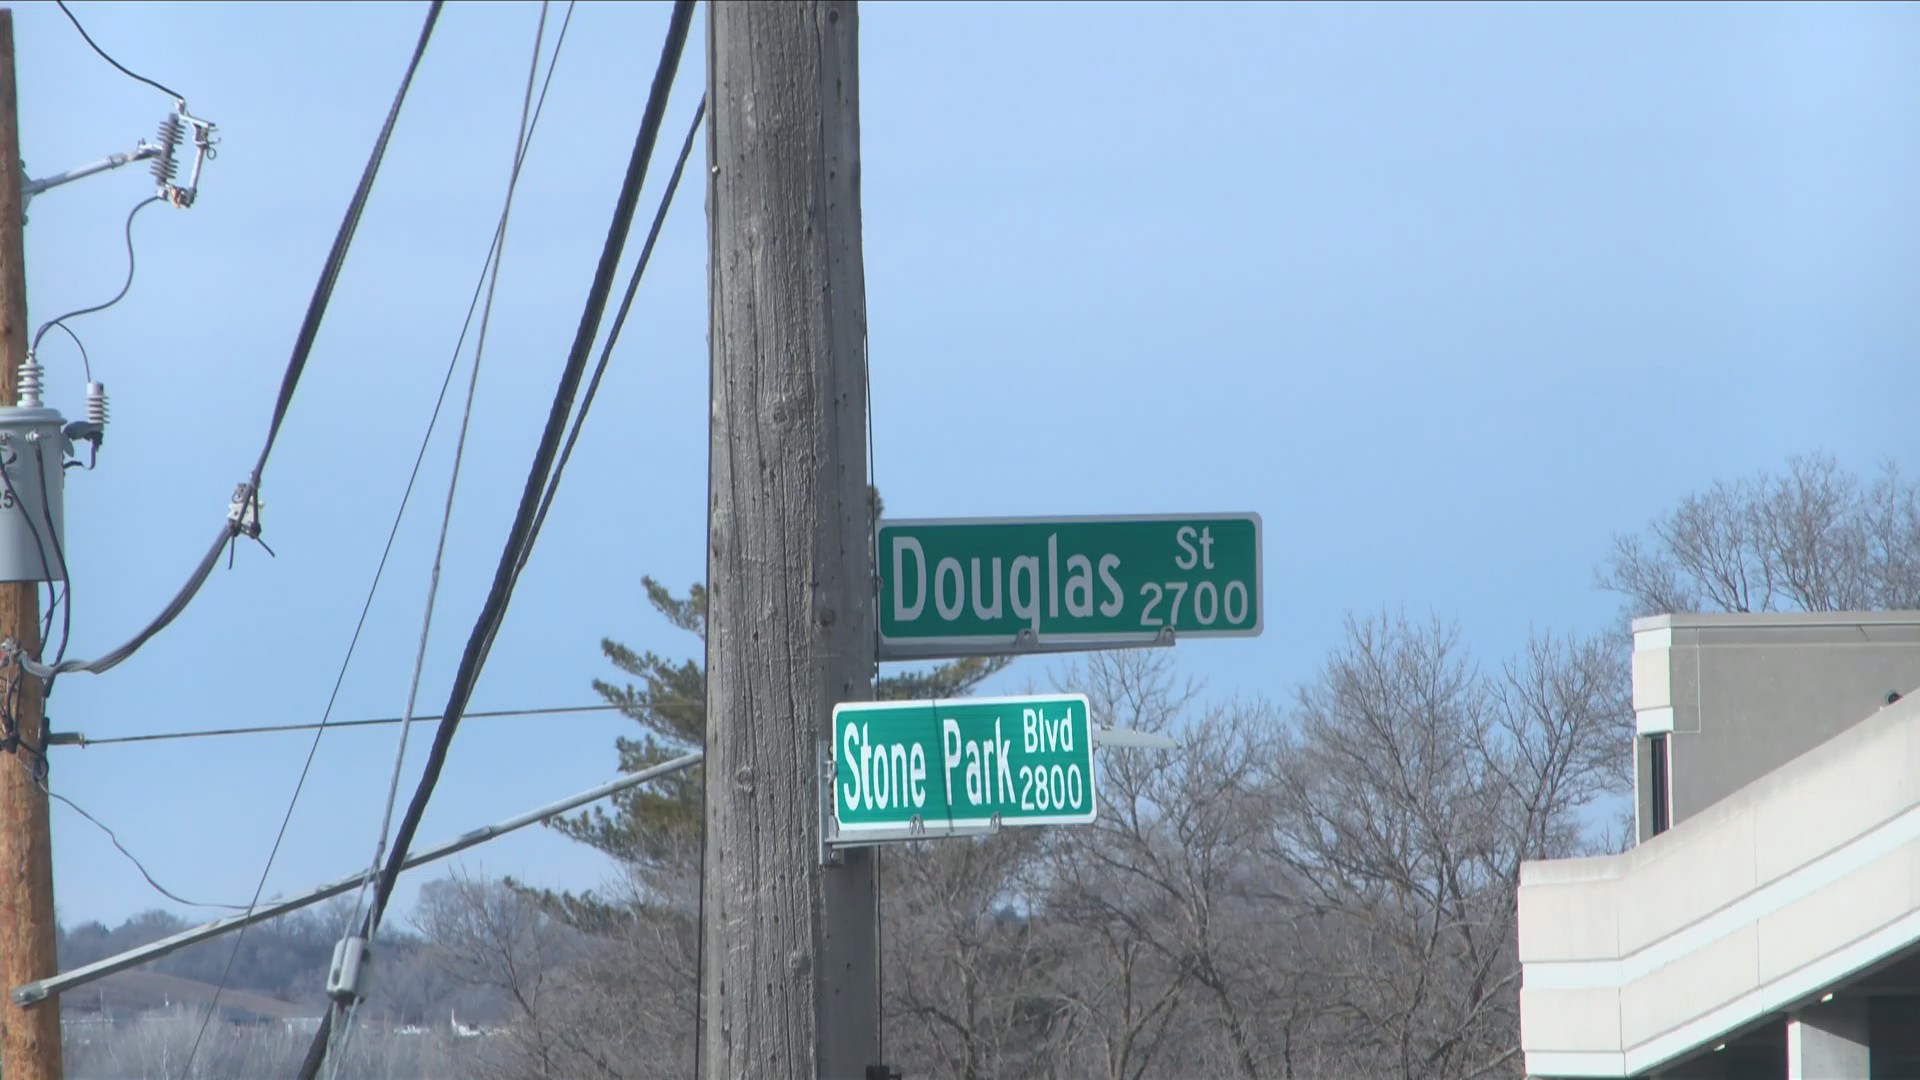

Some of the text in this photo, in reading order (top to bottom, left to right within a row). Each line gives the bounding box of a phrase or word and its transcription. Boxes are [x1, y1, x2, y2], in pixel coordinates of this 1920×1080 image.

[0, 488, 15, 509] 5
[892, 526, 1215, 634] Douglas St
[1139, 580, 1249, 627] 2700
[843, 707, 1074, 812] Stone Park Blvd
[1019, 763, 1083, 811] 2800
